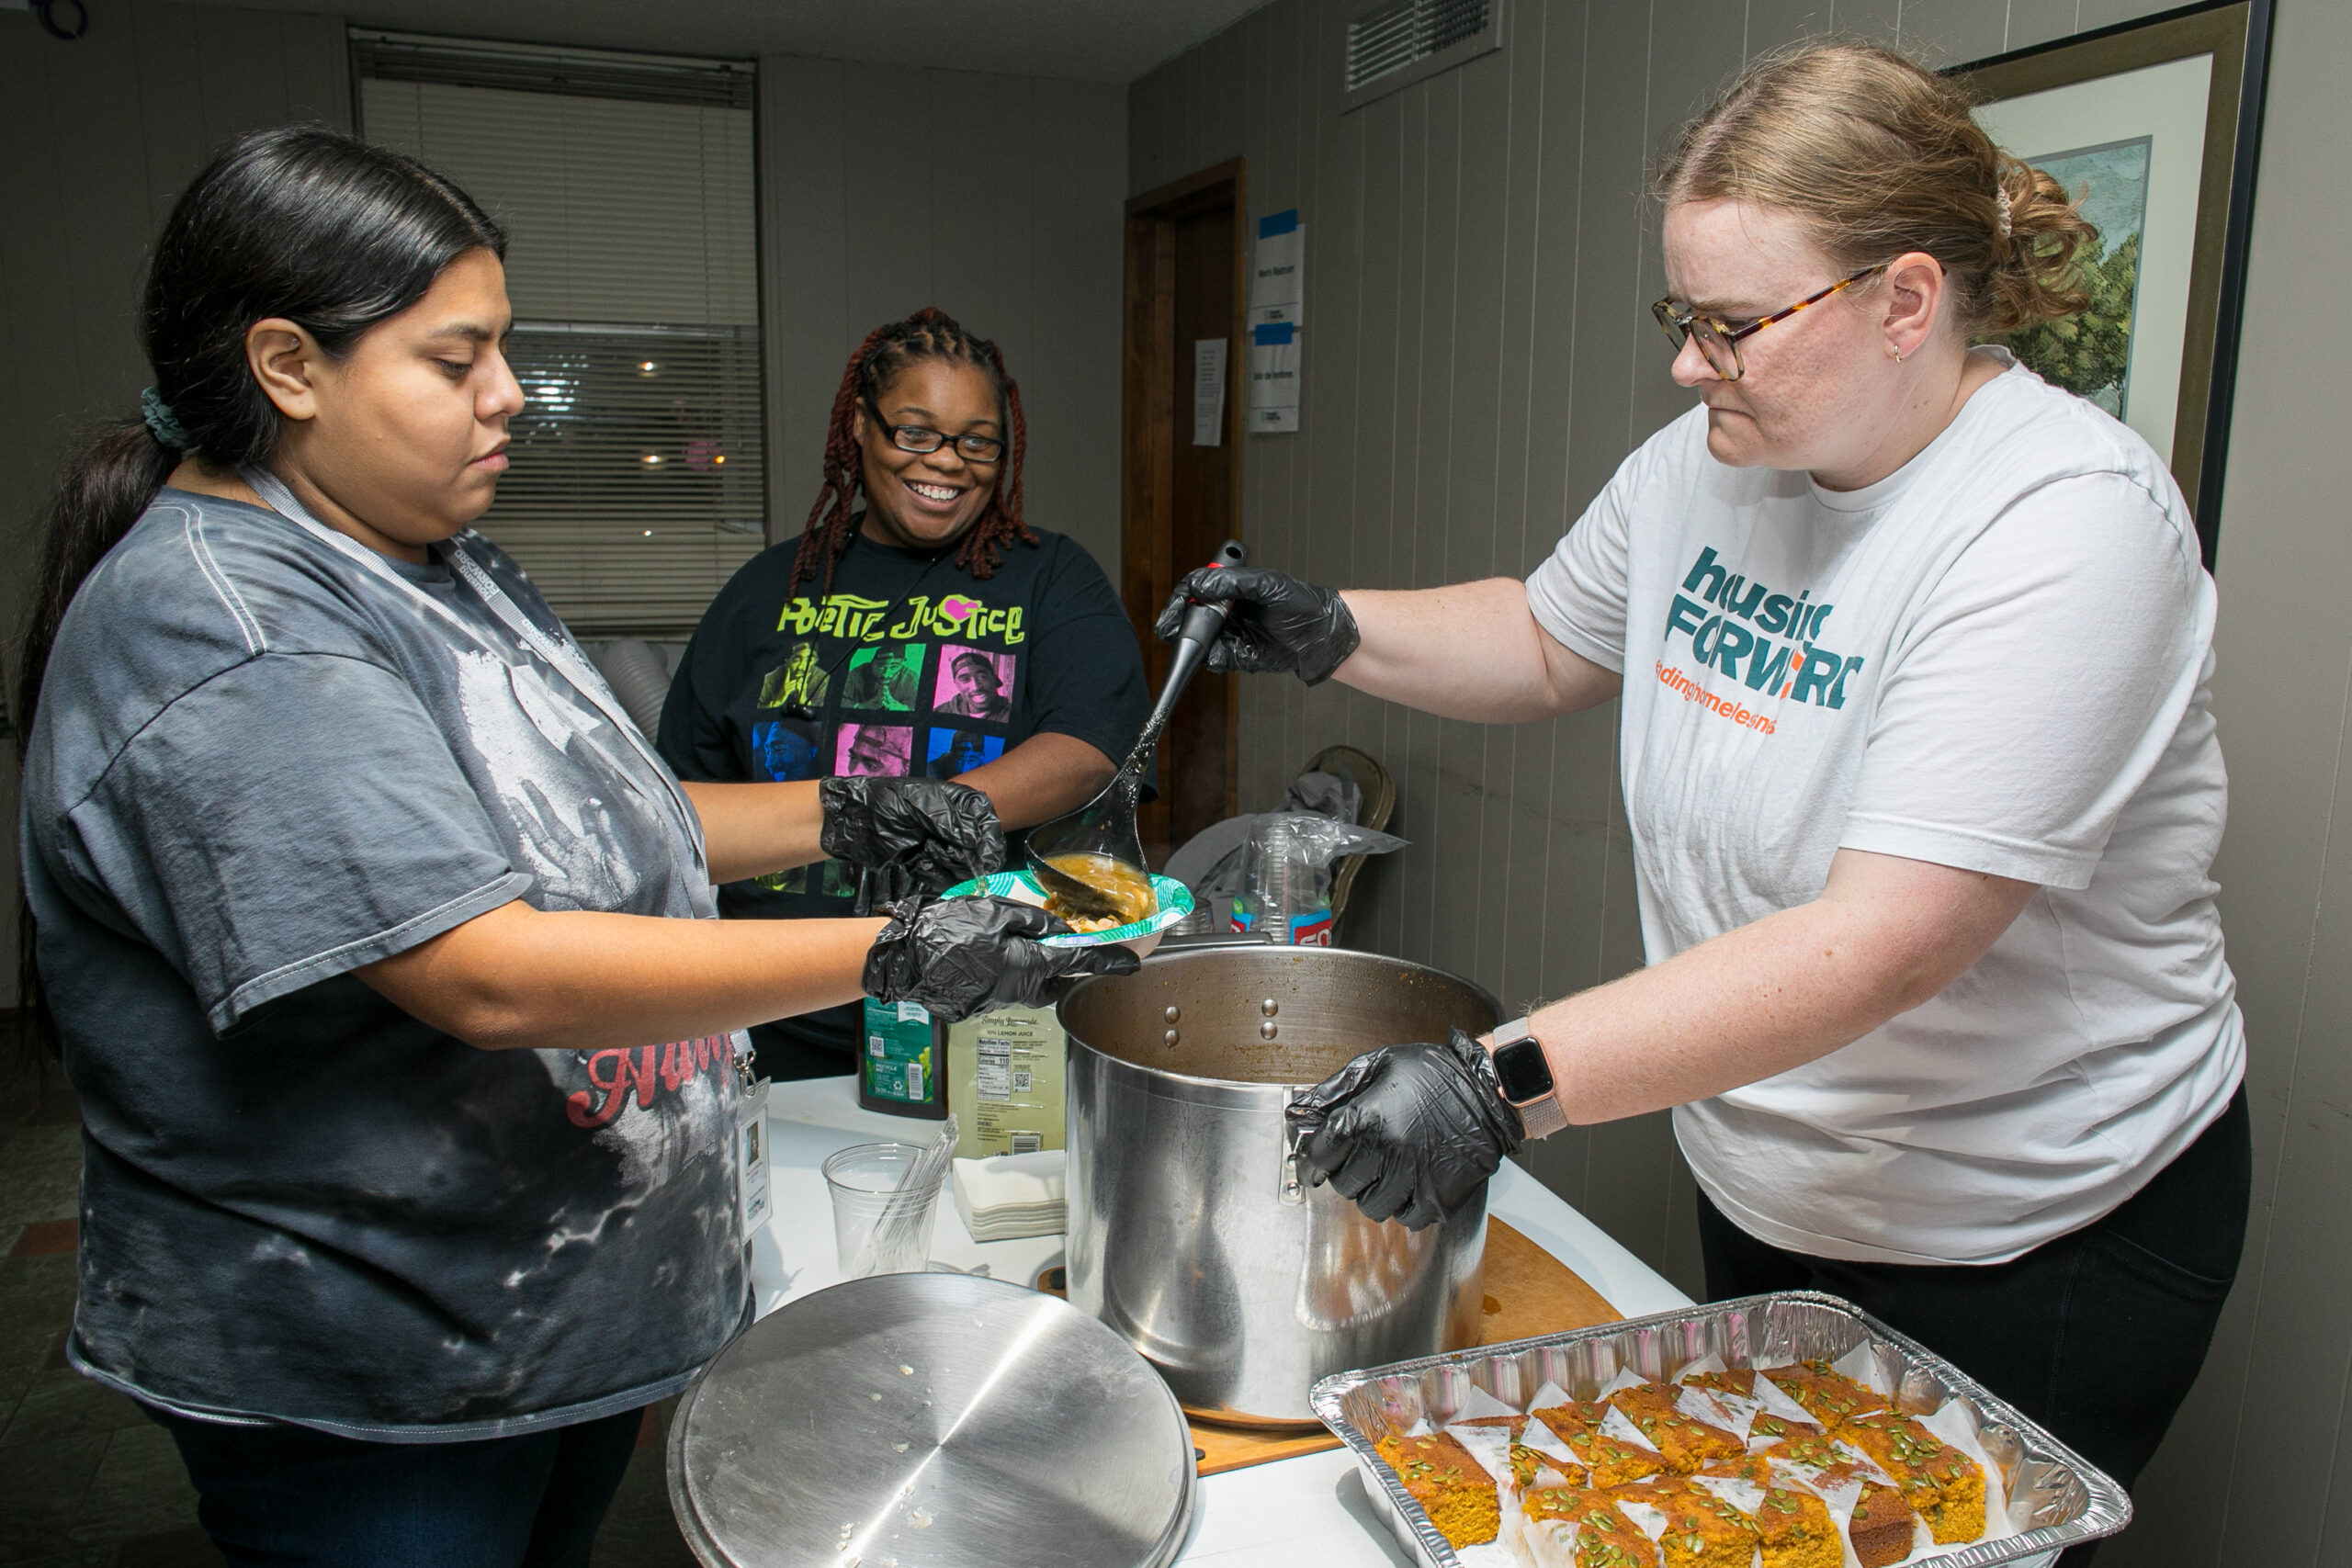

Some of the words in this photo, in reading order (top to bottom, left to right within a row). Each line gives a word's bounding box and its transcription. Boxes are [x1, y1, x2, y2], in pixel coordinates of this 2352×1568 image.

[459, 567, 492, 602] housing
[1656, 660, 1694, 701] ding
[1005, 1016, 1037, 1027] Lade
